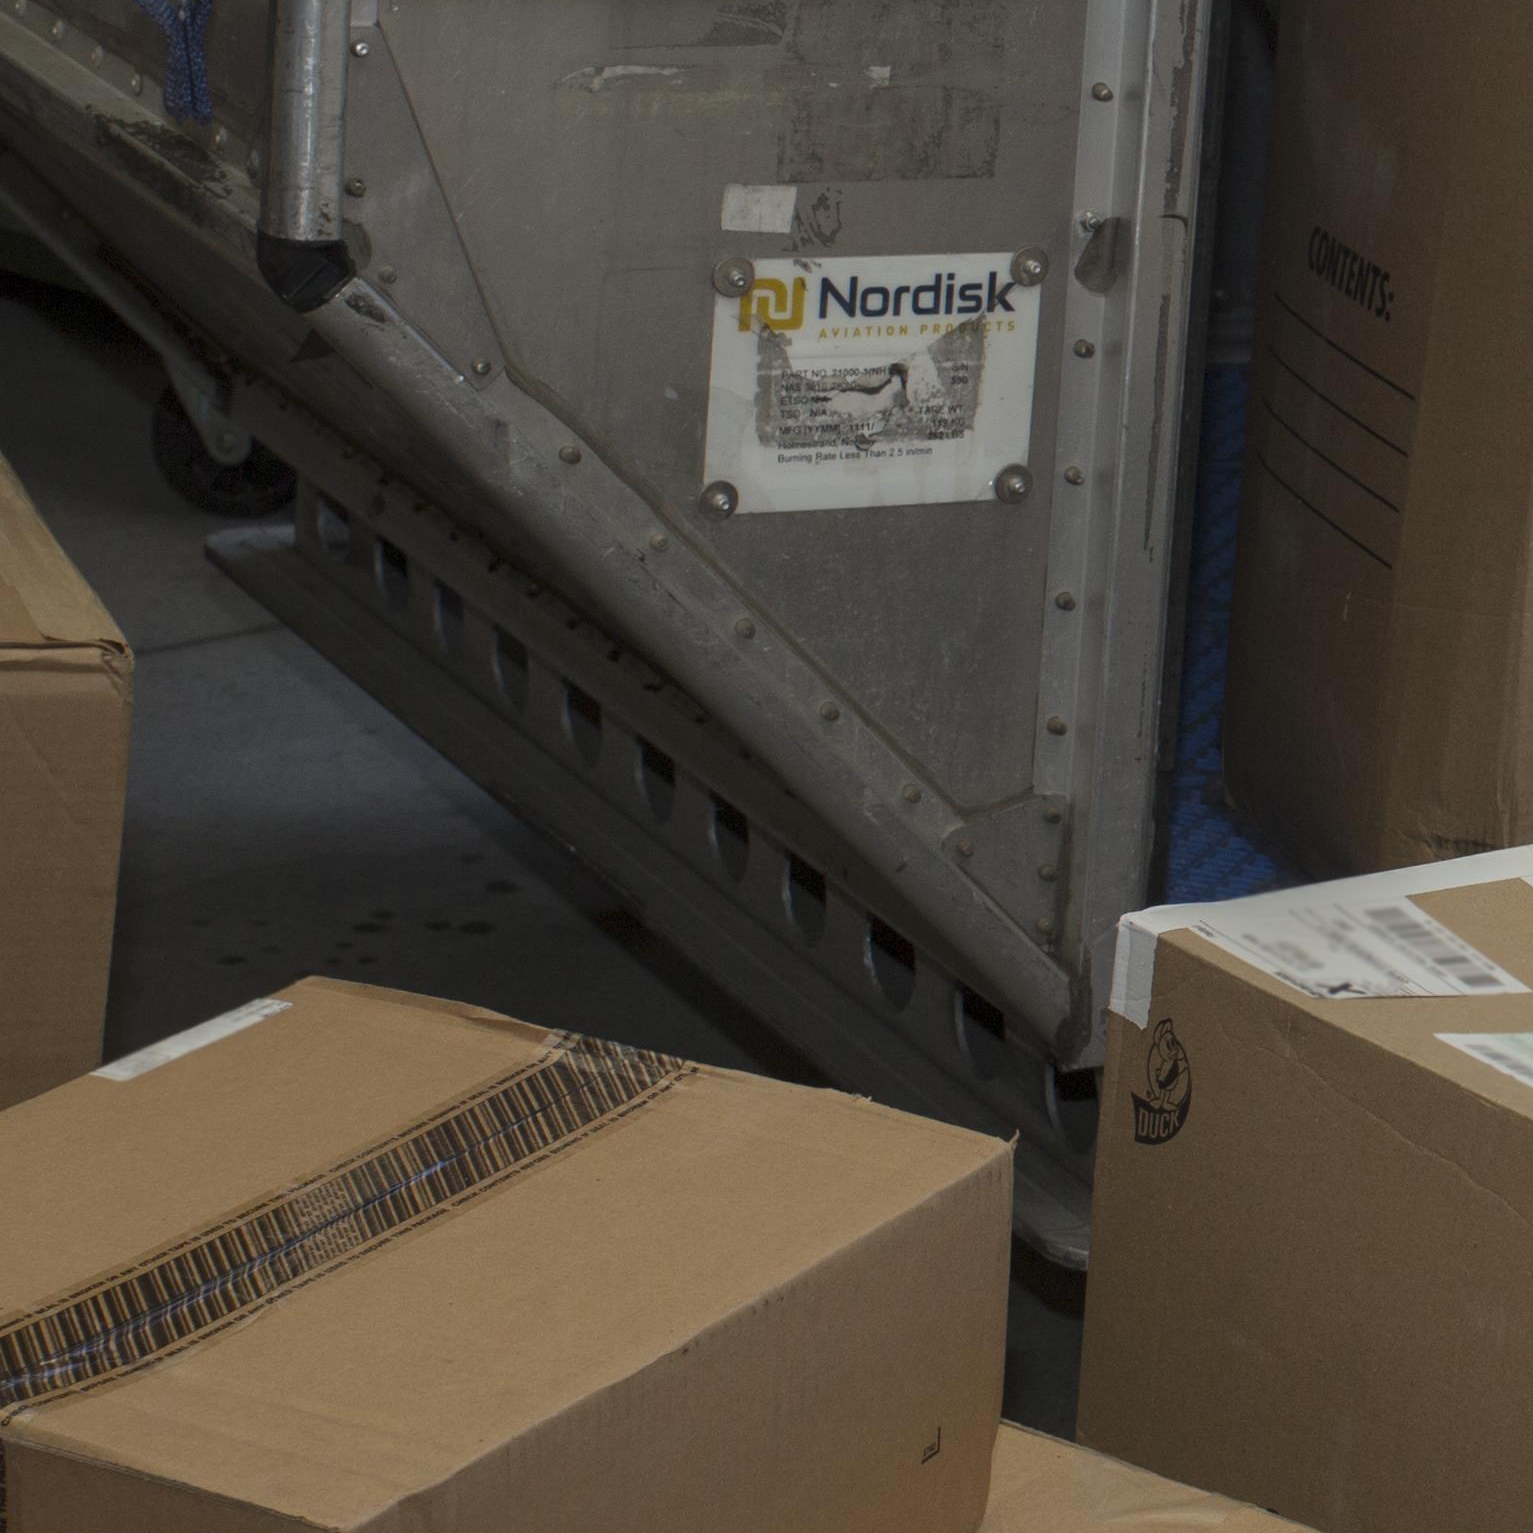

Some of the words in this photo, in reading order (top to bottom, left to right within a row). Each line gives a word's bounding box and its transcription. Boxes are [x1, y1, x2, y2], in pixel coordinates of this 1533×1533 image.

[1307, 225, 1395, 322] CONTENTS:
[819, 272, 1016, 319] Nordisk
[819, 325, 909, 340] AVIATION
[919, 321, 1016, 334] PRODUCTS
[816, 452, 837, 461] Rate
[840, 450, 861, 460] Less
[1138, 1107, 1180, 1138] DUCK
